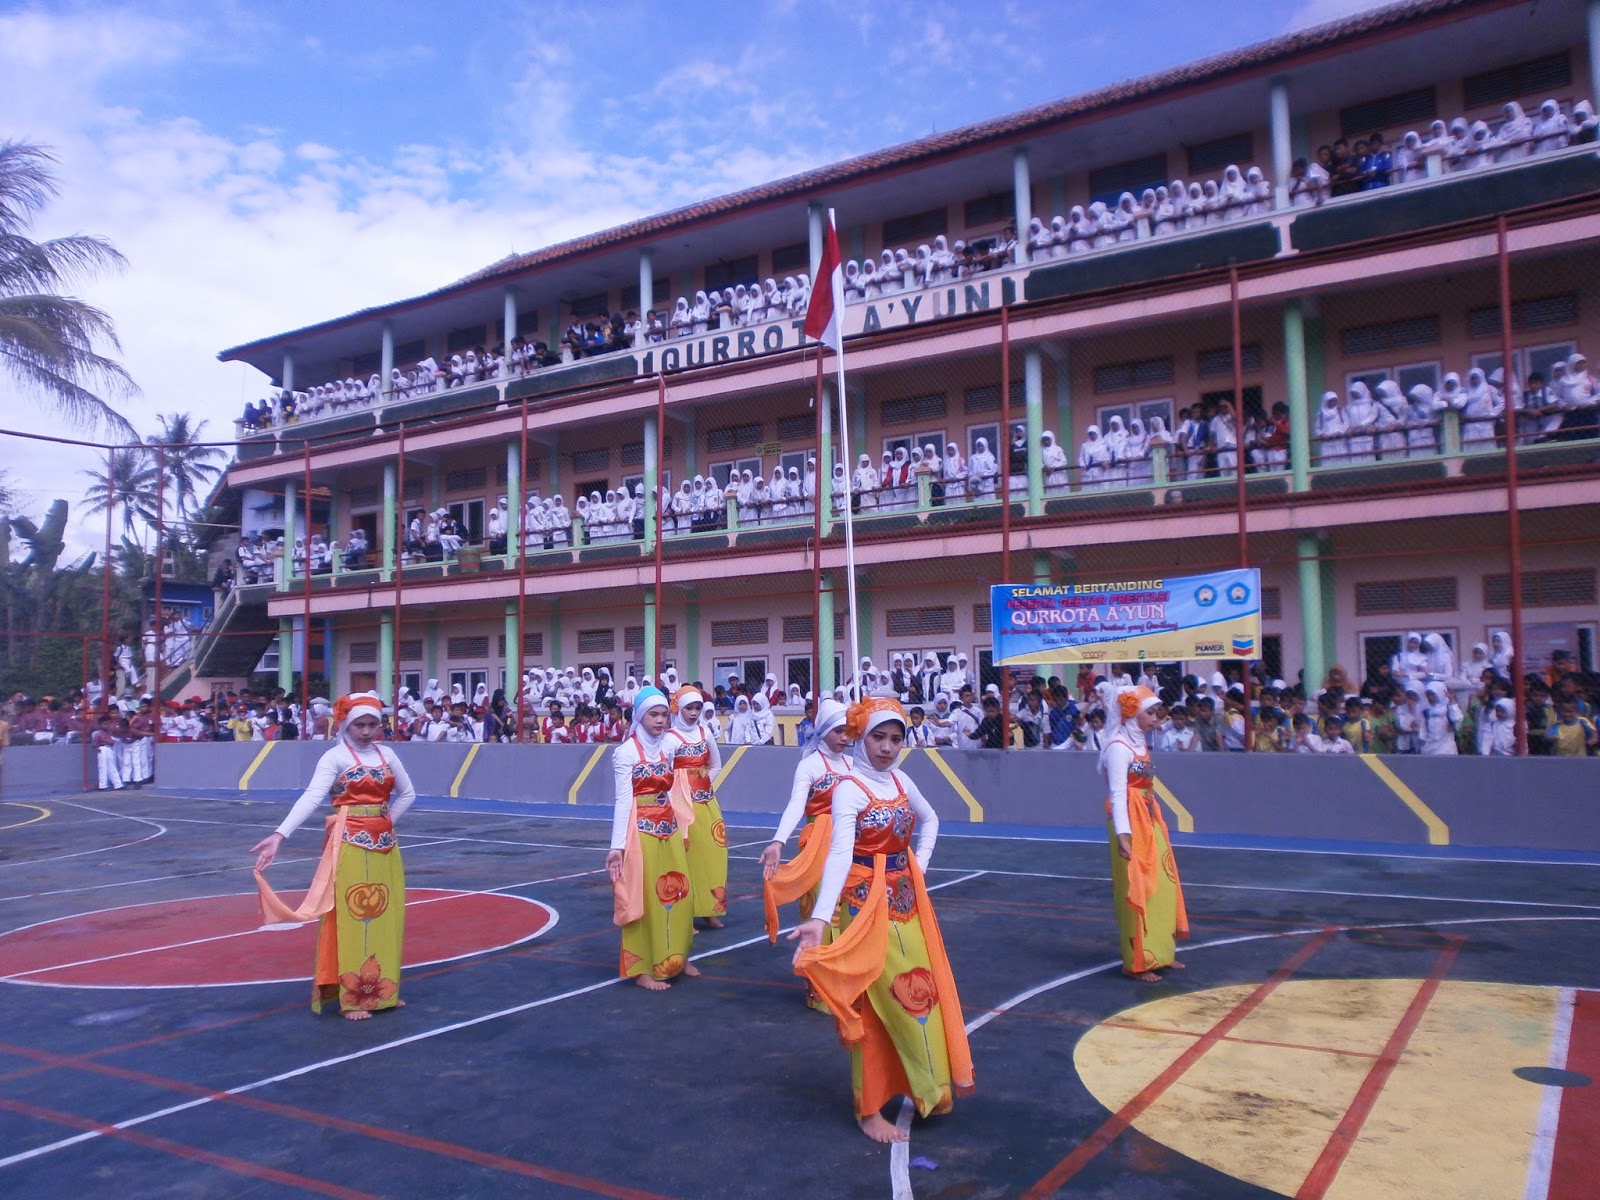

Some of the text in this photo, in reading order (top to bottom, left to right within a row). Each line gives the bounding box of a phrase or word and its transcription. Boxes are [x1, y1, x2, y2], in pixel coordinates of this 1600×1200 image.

[661, 281, 990, 373] QURROT A'YUN
[1011, 579, 1164, 597] SELAMAT BERTANDING
[1007, 591, 1171, 609] PESERTA GEBYAR PRESTASI
[1011, 603, 1166, 626] QURROTA A'YUN
[1195, 644, 1225, 652] POWER
